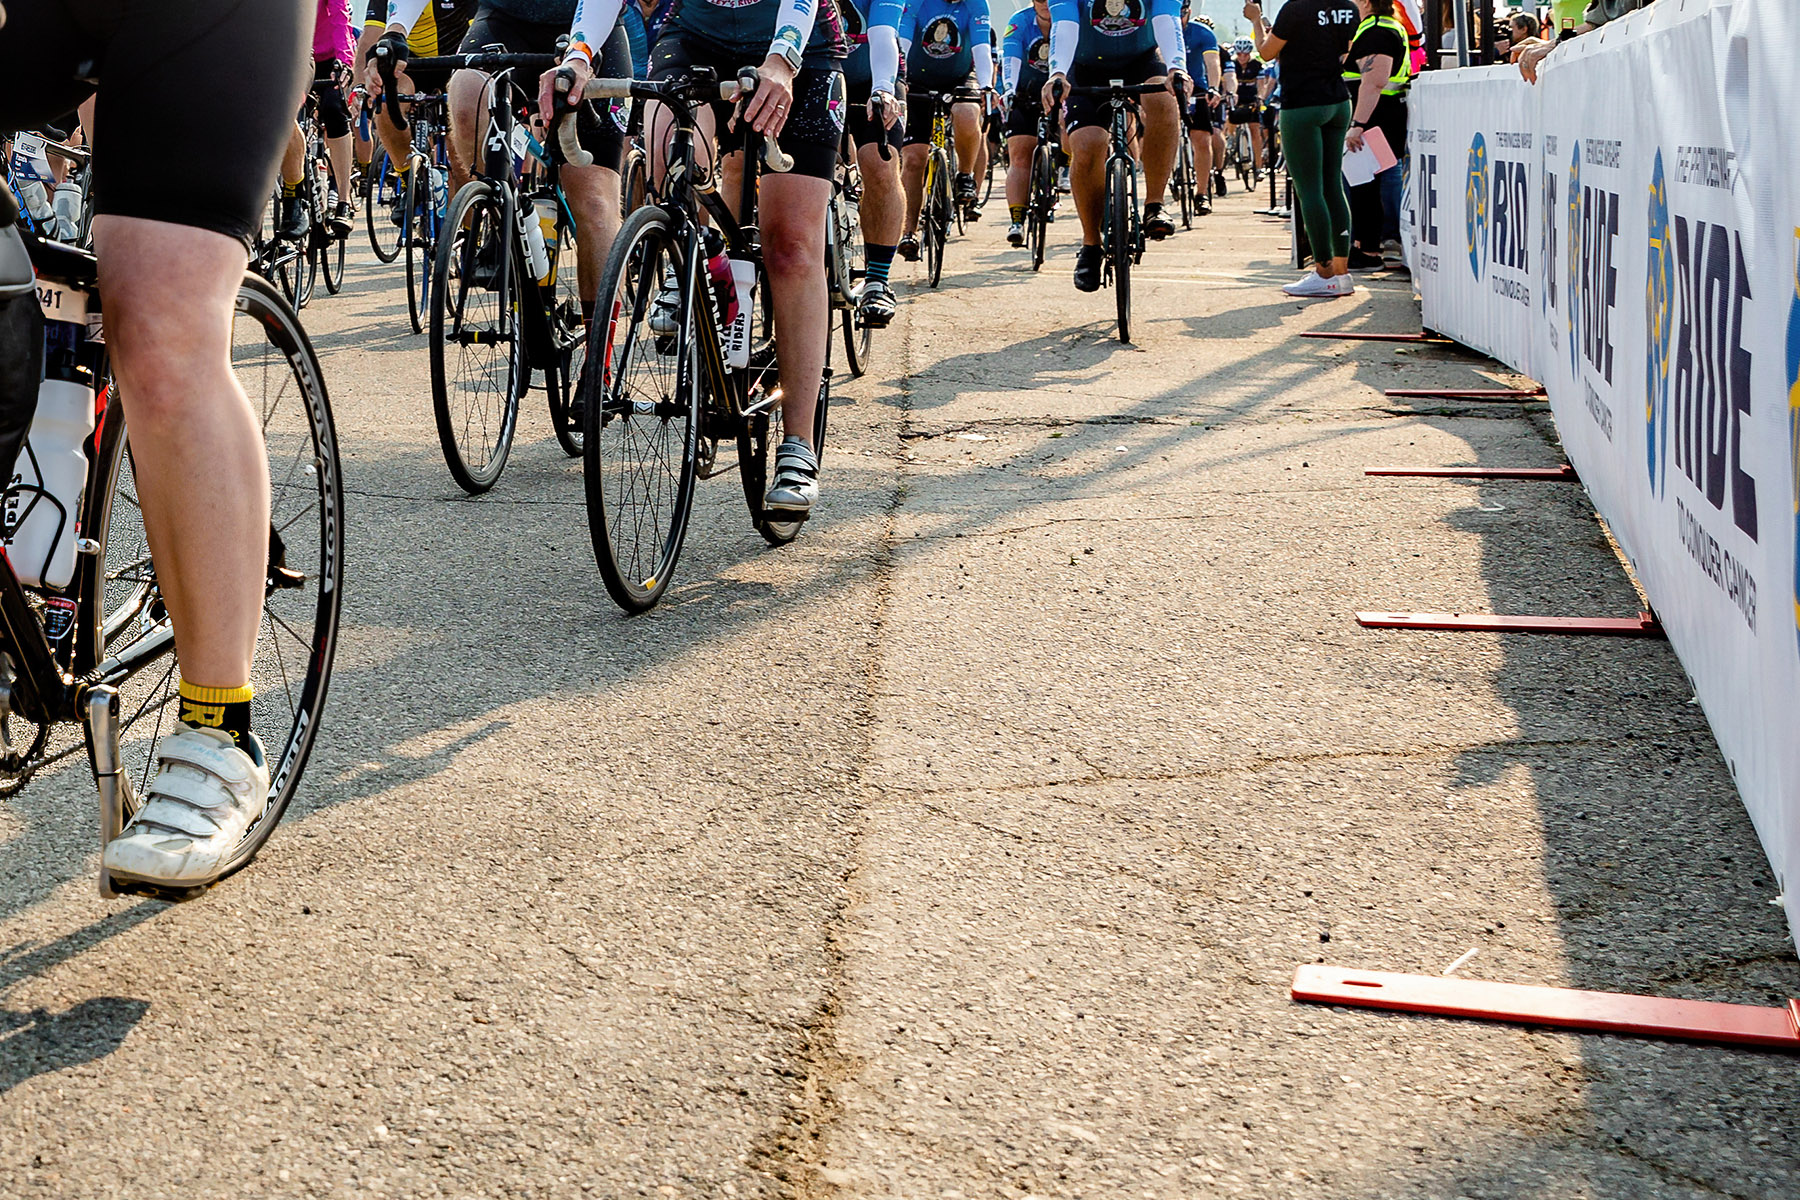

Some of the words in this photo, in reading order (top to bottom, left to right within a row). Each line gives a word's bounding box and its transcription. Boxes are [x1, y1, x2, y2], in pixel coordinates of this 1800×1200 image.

[1318, 10, 1353, 26] SAFF
[1492, 160, 1531, 275] RID
[732, 312, 746, 352] RIDERS
[1582, 185, 1620, 388] RIDE
[1674, 213, 1758, 546] RIDE
[1686, 507, 1725, 592] CONQUER
[1723, 549, 1757, 637] CANCER
